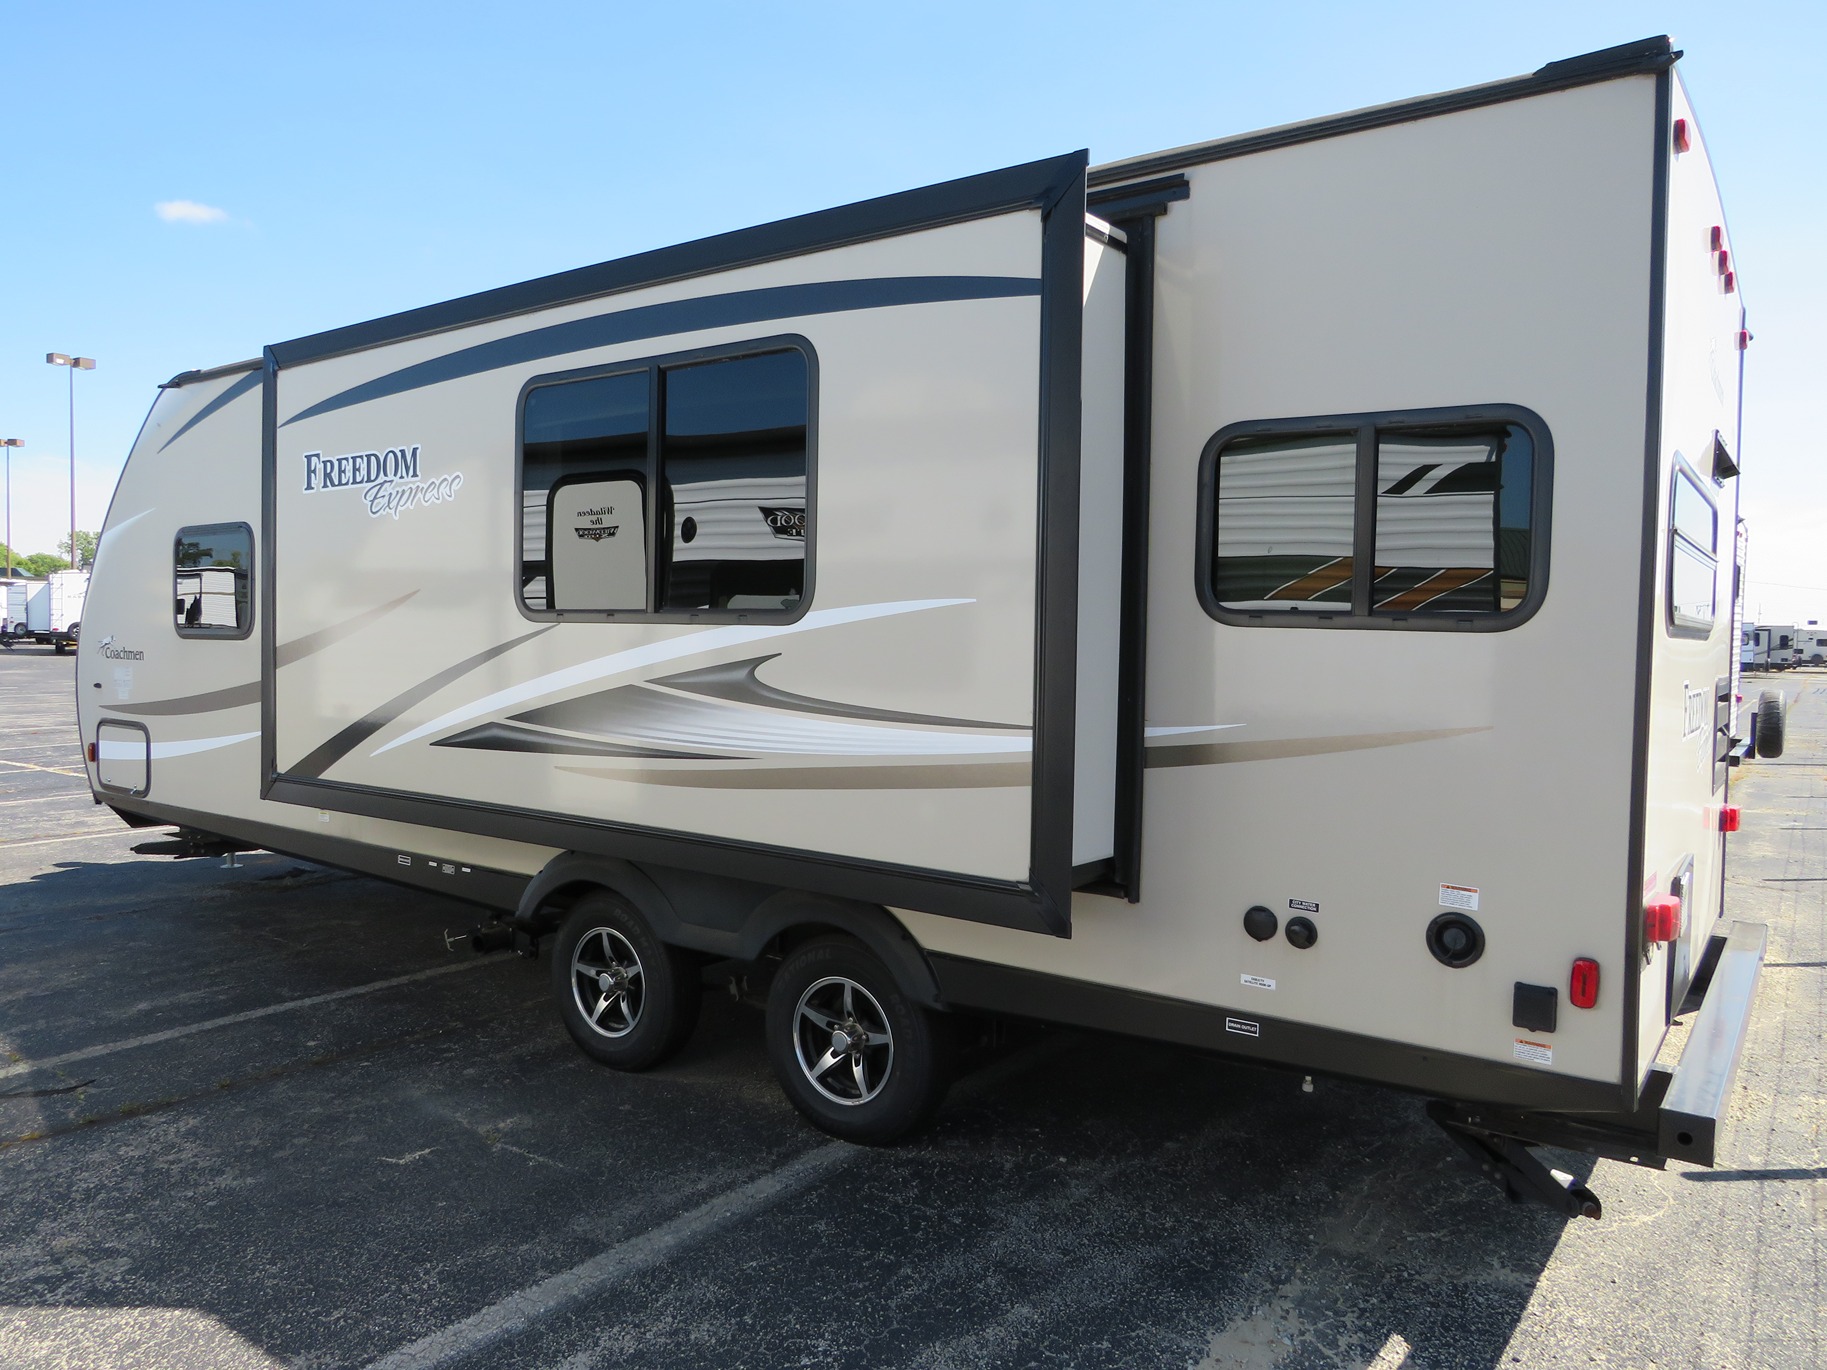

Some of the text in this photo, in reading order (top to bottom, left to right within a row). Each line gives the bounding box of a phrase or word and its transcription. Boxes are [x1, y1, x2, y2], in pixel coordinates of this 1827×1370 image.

[303, 446, 420, 492] FREEDOM
[363, 473, 462, 517] Express
[104, 646, 145, 661] Coachmen
